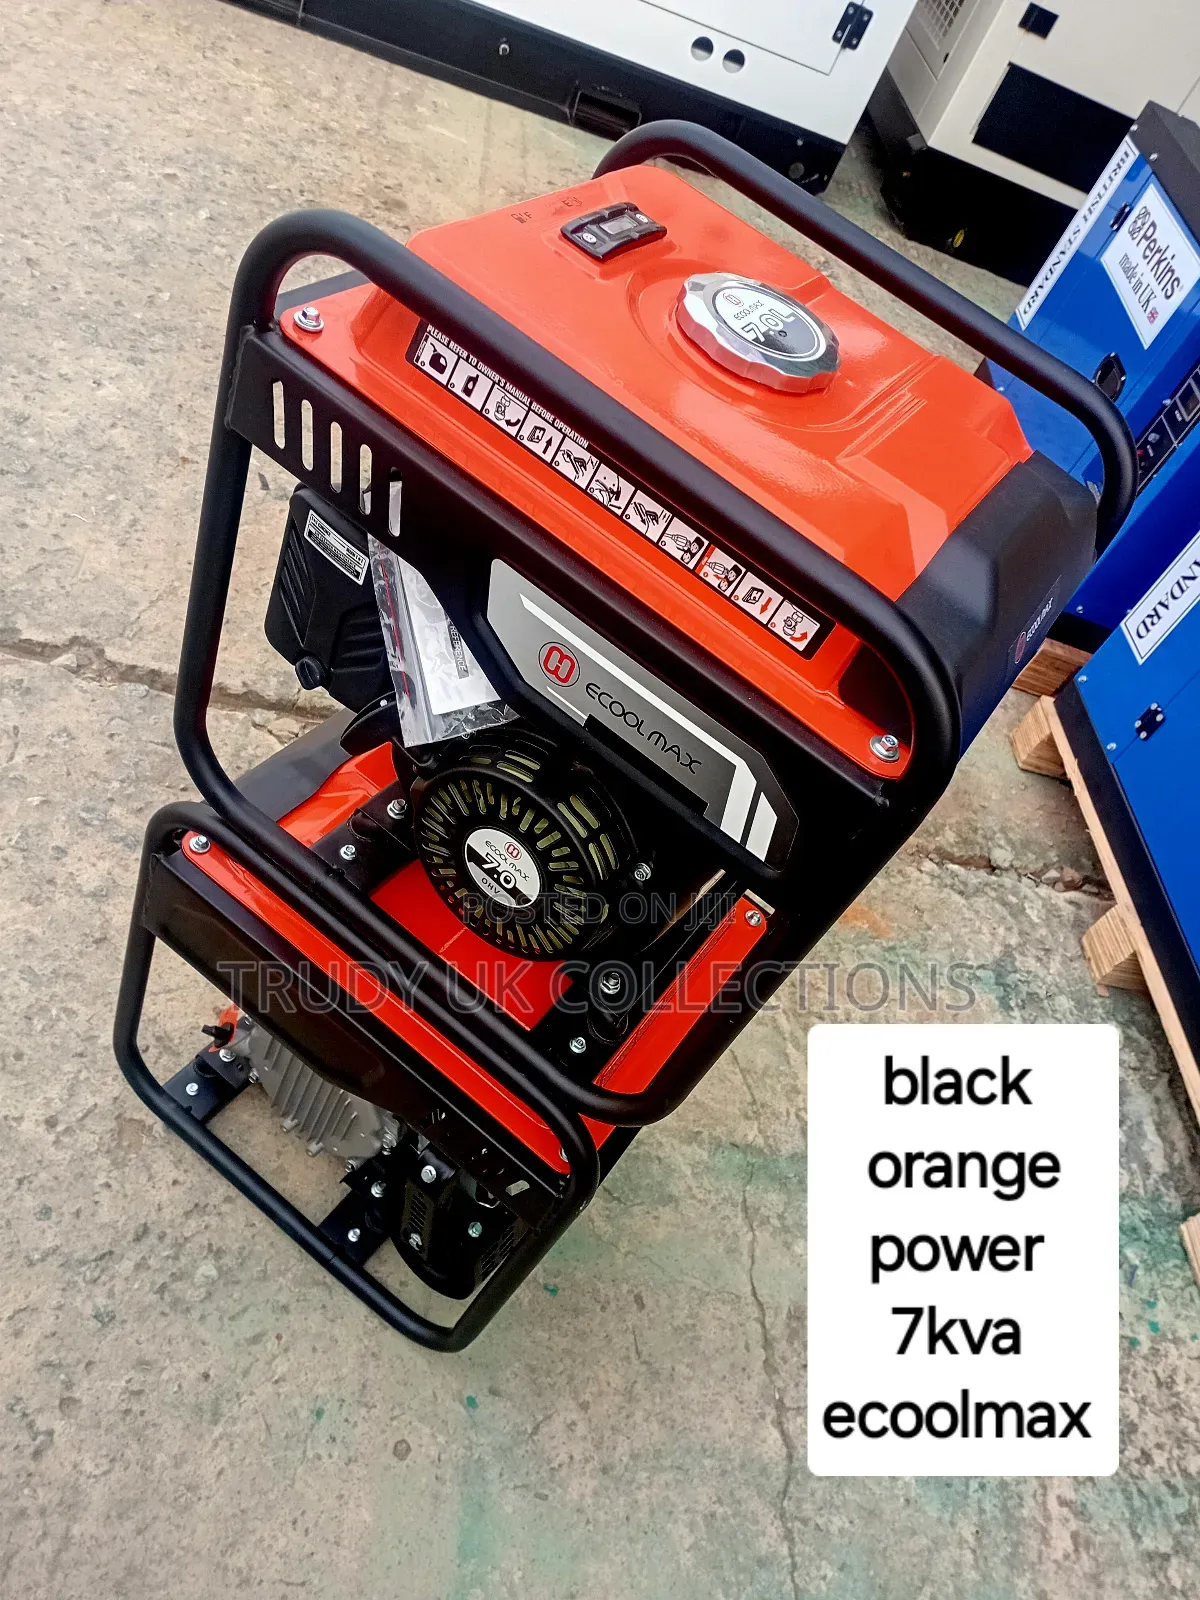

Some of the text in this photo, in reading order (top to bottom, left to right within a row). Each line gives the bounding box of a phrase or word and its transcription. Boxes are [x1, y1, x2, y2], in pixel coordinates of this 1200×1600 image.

[1022, 224, 1081, 315] STANDARD
[1119, 252, 1158, 313] made in UK
[1136, 219, 1181, 300] Perkins
[426, 323, 450, 348] PLEASE
[448, 340, 469, 359] REFER
[468, 353, 478, 367] TO
[476, 361, 506, 386] OWNER'S
[504, 380, 531, 406] MANUAL
[530, 399, 556, 424] BEFORE
[553, 416, 589, 449] OPERATION
[481, 852, 517, 889] 7.0
[481, 877, 501, 894] OHV
